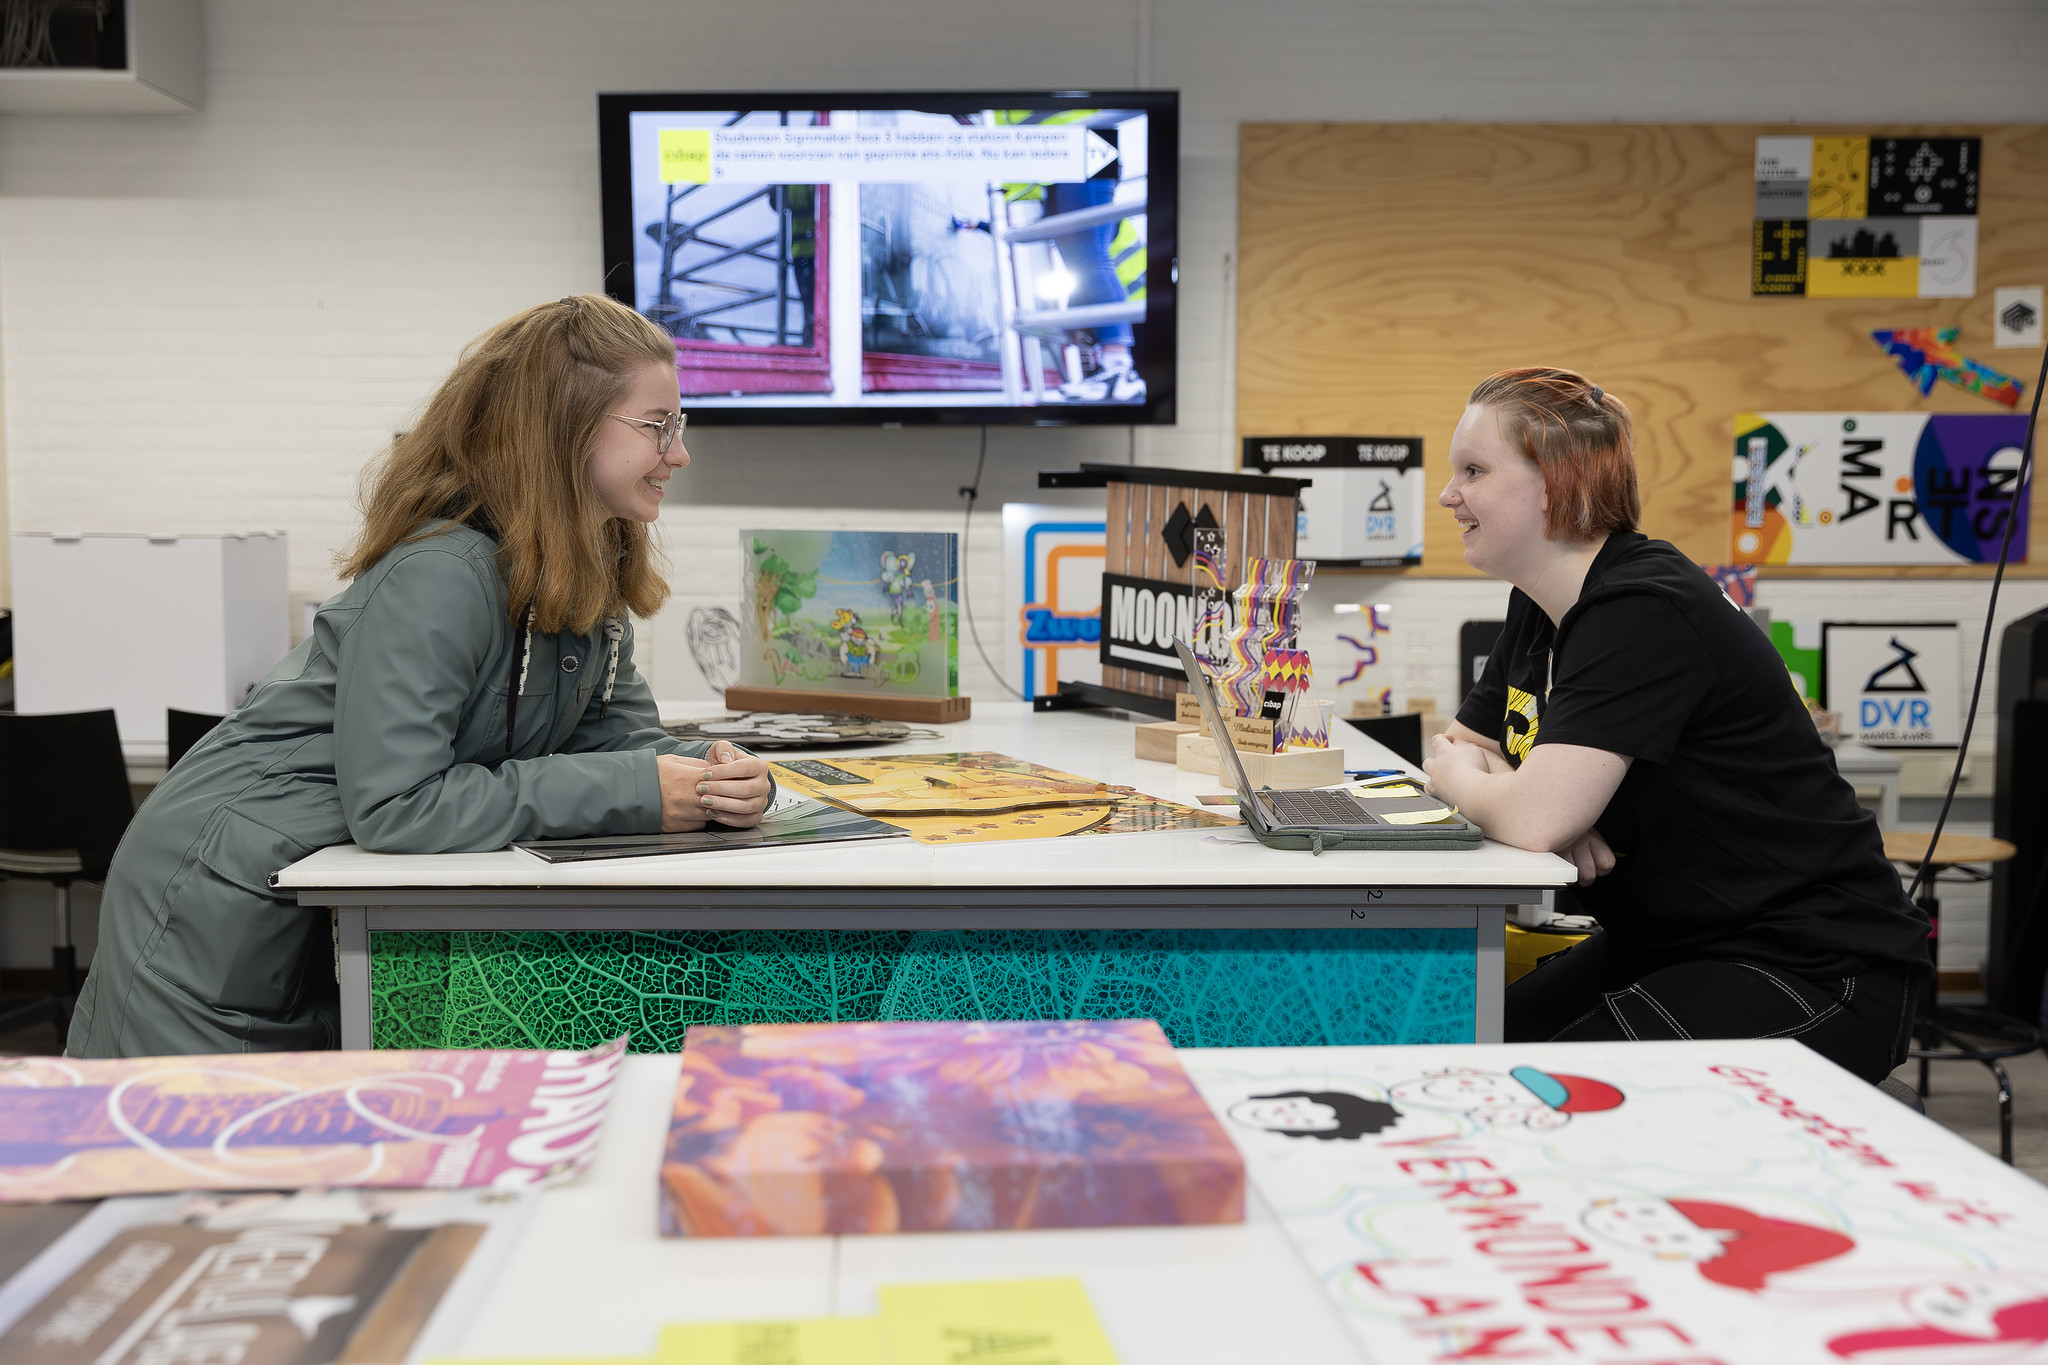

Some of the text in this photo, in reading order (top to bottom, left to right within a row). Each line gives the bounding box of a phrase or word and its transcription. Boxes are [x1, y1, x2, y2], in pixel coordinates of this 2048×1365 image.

[714, 131, 780, 145] Studenten
[785, 131, 850, 147] Signmaker
[855, 131, 880, 145] fase
[896, 130, 942, 145] hebben
[948, 133, 963, 147] op
[967, 131, 1012, 145] station
[1015, 130, 1068, 147] Kampen
[714, 149, 730, 162] de
[735, 150, 775, 162] ramen
[779, 149, 834, 162] voorzien
[838, 150, 859, 162] van
[863, 149, 917, 165] geprinte
[980, 148, 1001, 161] Nu
[1004, 148, 1026, 161] kan
[1030, 148, 1071, 161] iedere
[1262, 444, 1327, 462] TE KOOP
[1358, 444, 1410, 462] TE KOOP
[1366, 515, 1397, 535] DVR
[1263, 699, 1282, 710] cibap
[1861, 698, 1931, 728] DVR
[1366, 889, 1384, 903] 2
[1350, 908, 1366, 921] 2
